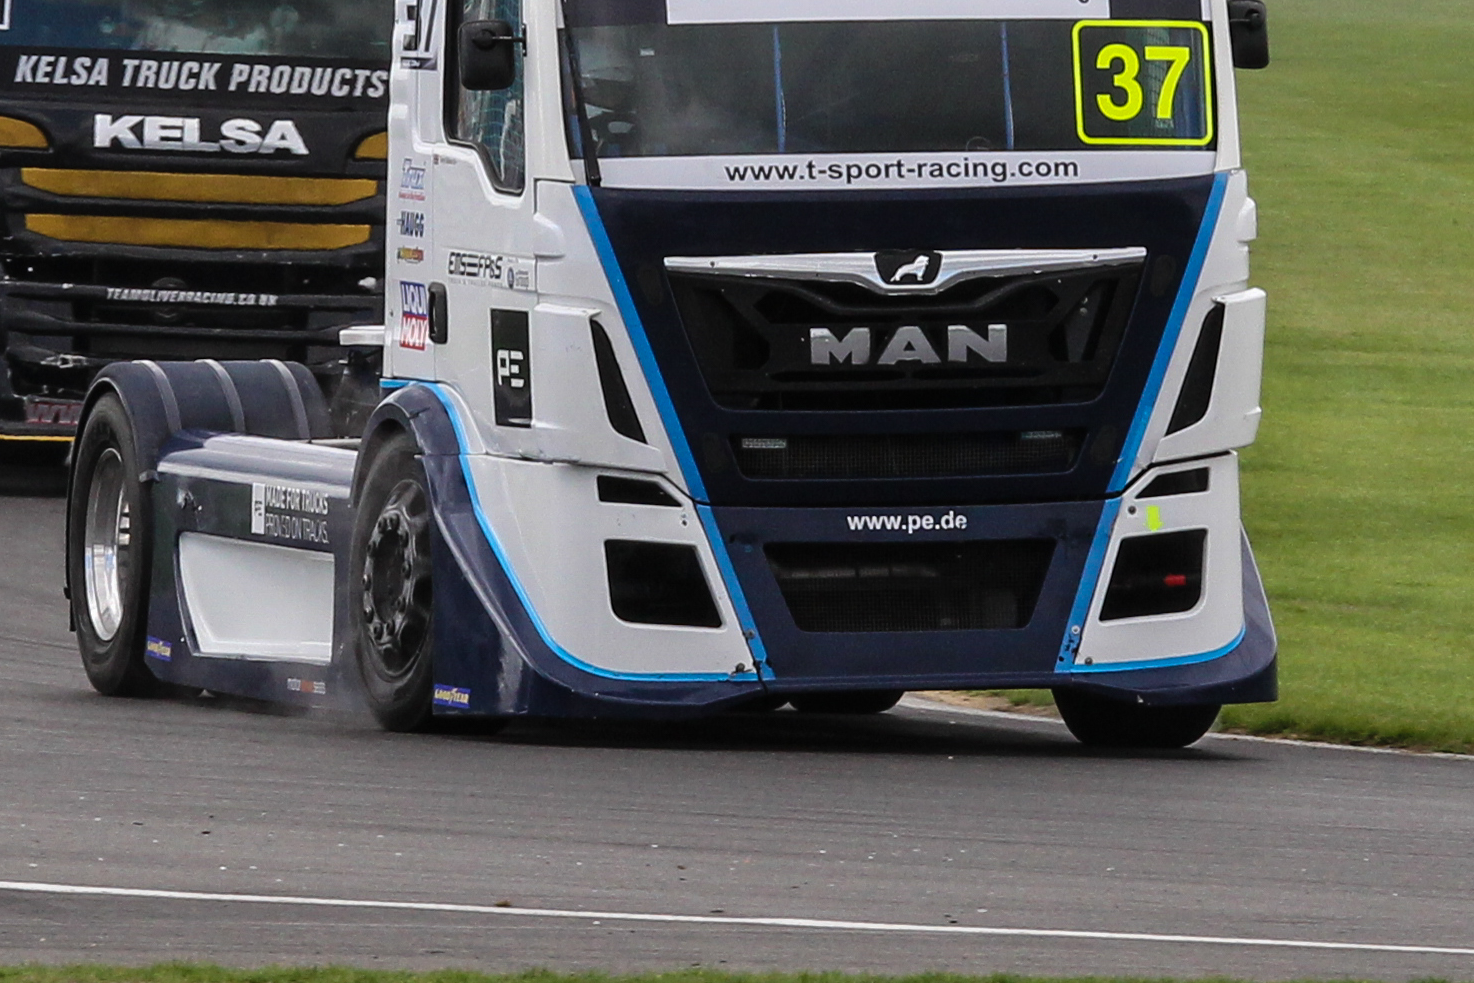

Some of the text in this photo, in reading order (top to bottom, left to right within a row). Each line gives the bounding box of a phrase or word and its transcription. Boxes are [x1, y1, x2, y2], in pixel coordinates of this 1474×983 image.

[14, 55, 389, 98] KELSA TRUCK PRODUCTS
[1096, 43, 1191, 121] 37
[93, 114, 310, 156] KELSA
[724, 156, 1079, 185] www.t-sport-racing.com
[810, 324, 1008, 365] MAN
[847, 510, 967, 533] www.pe.de
